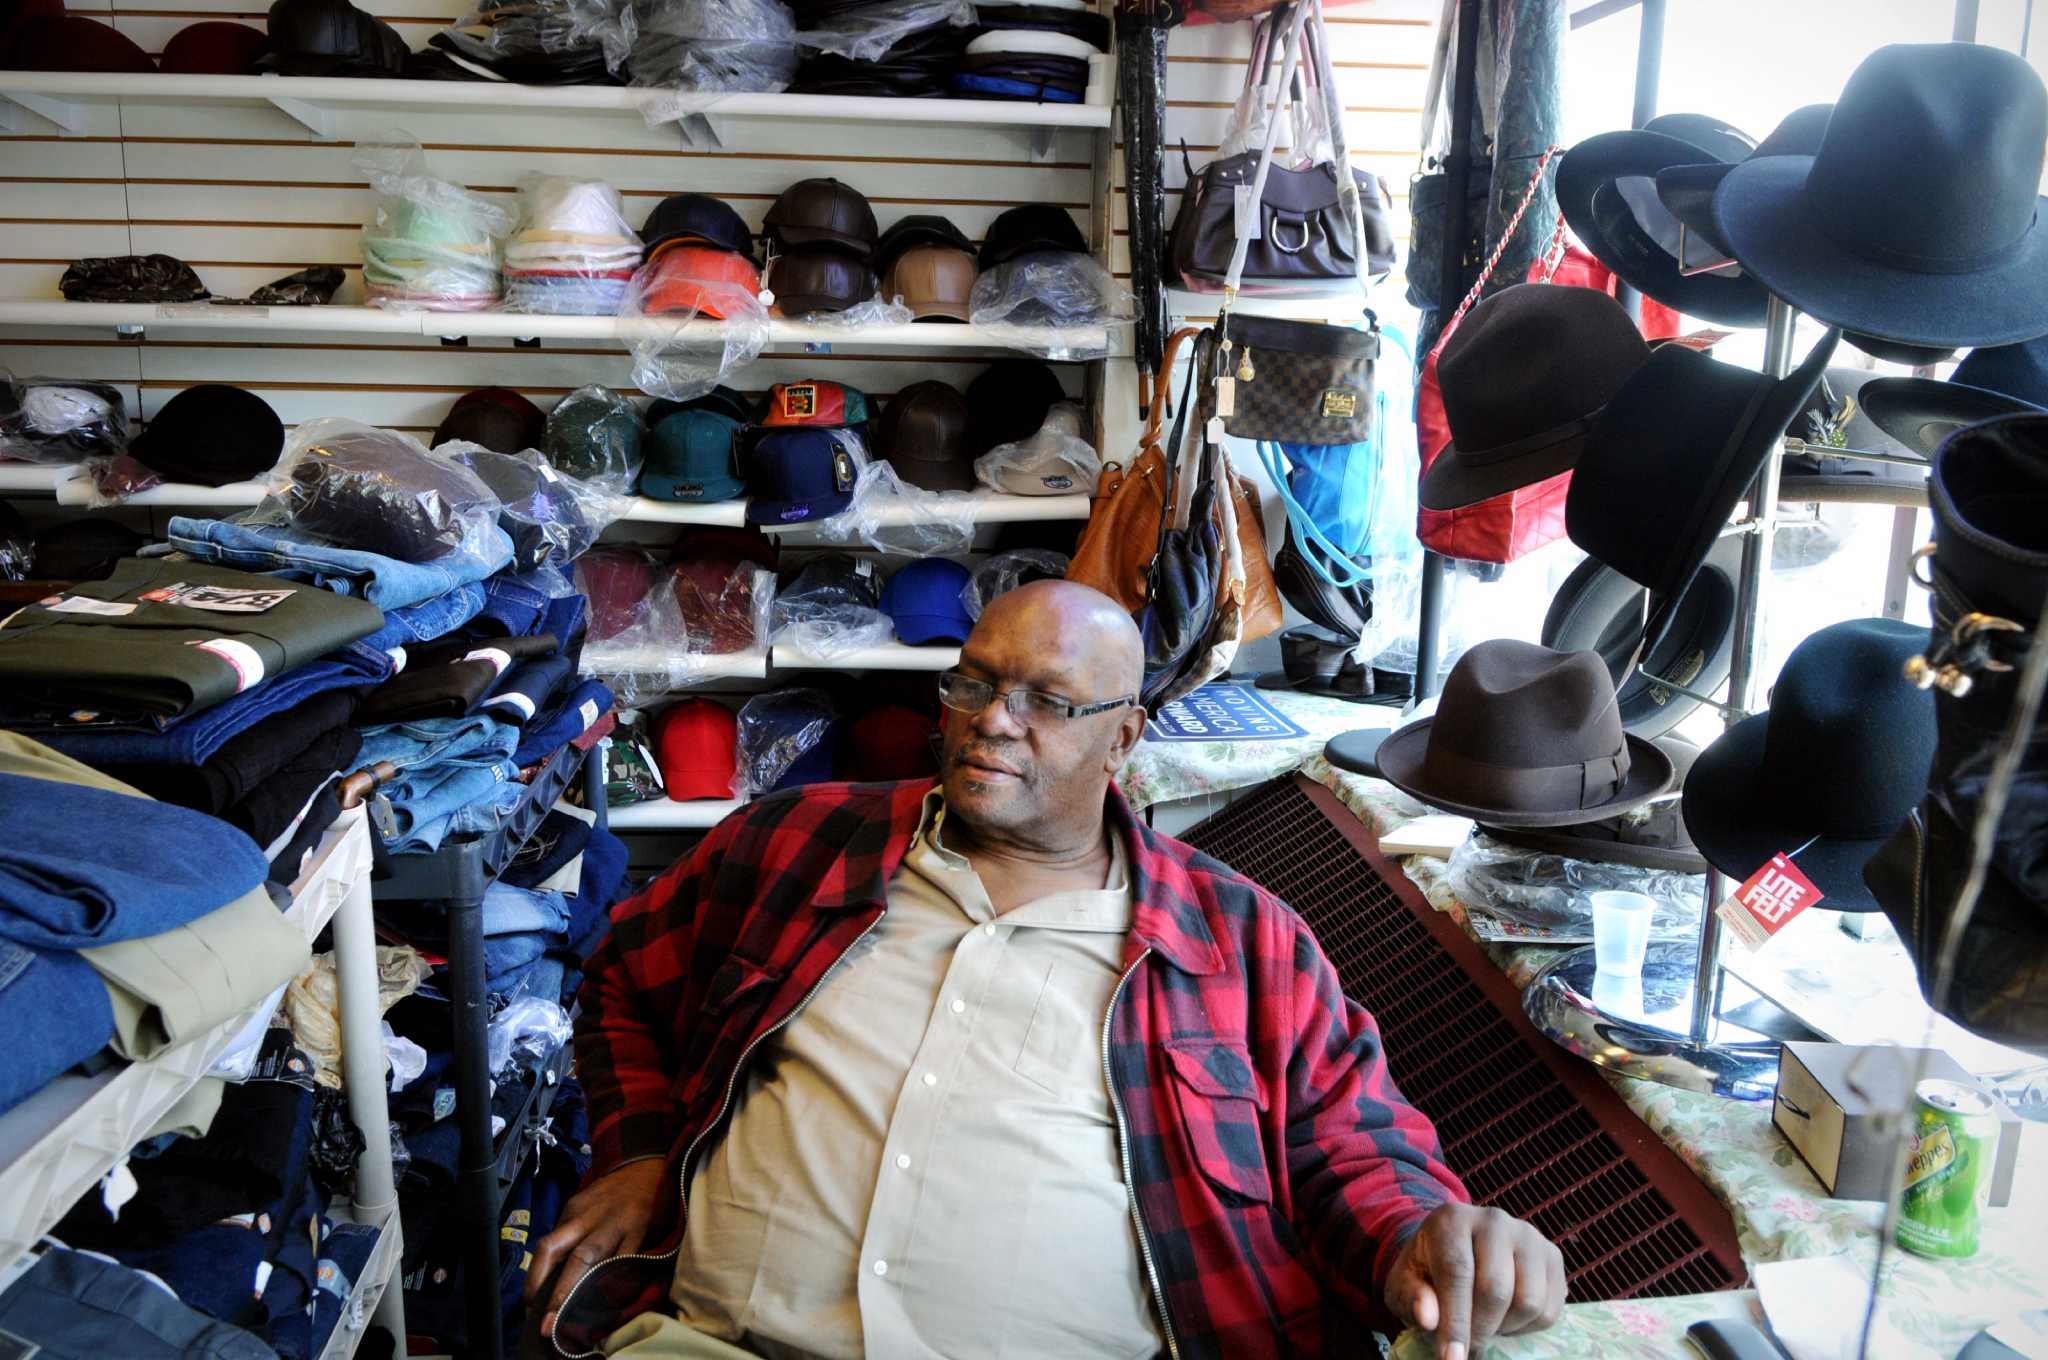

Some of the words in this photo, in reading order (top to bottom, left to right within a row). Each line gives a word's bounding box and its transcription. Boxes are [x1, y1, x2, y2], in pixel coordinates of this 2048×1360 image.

[1164, 701, 1209, 733] RWARD
[1187, 691, 1245, 733] AMERICA
[1215, 690, 1279, 732] MOVING
[1742, 883, 1793, 924] FELT
[1758, 866, 1807, 908] LITE
